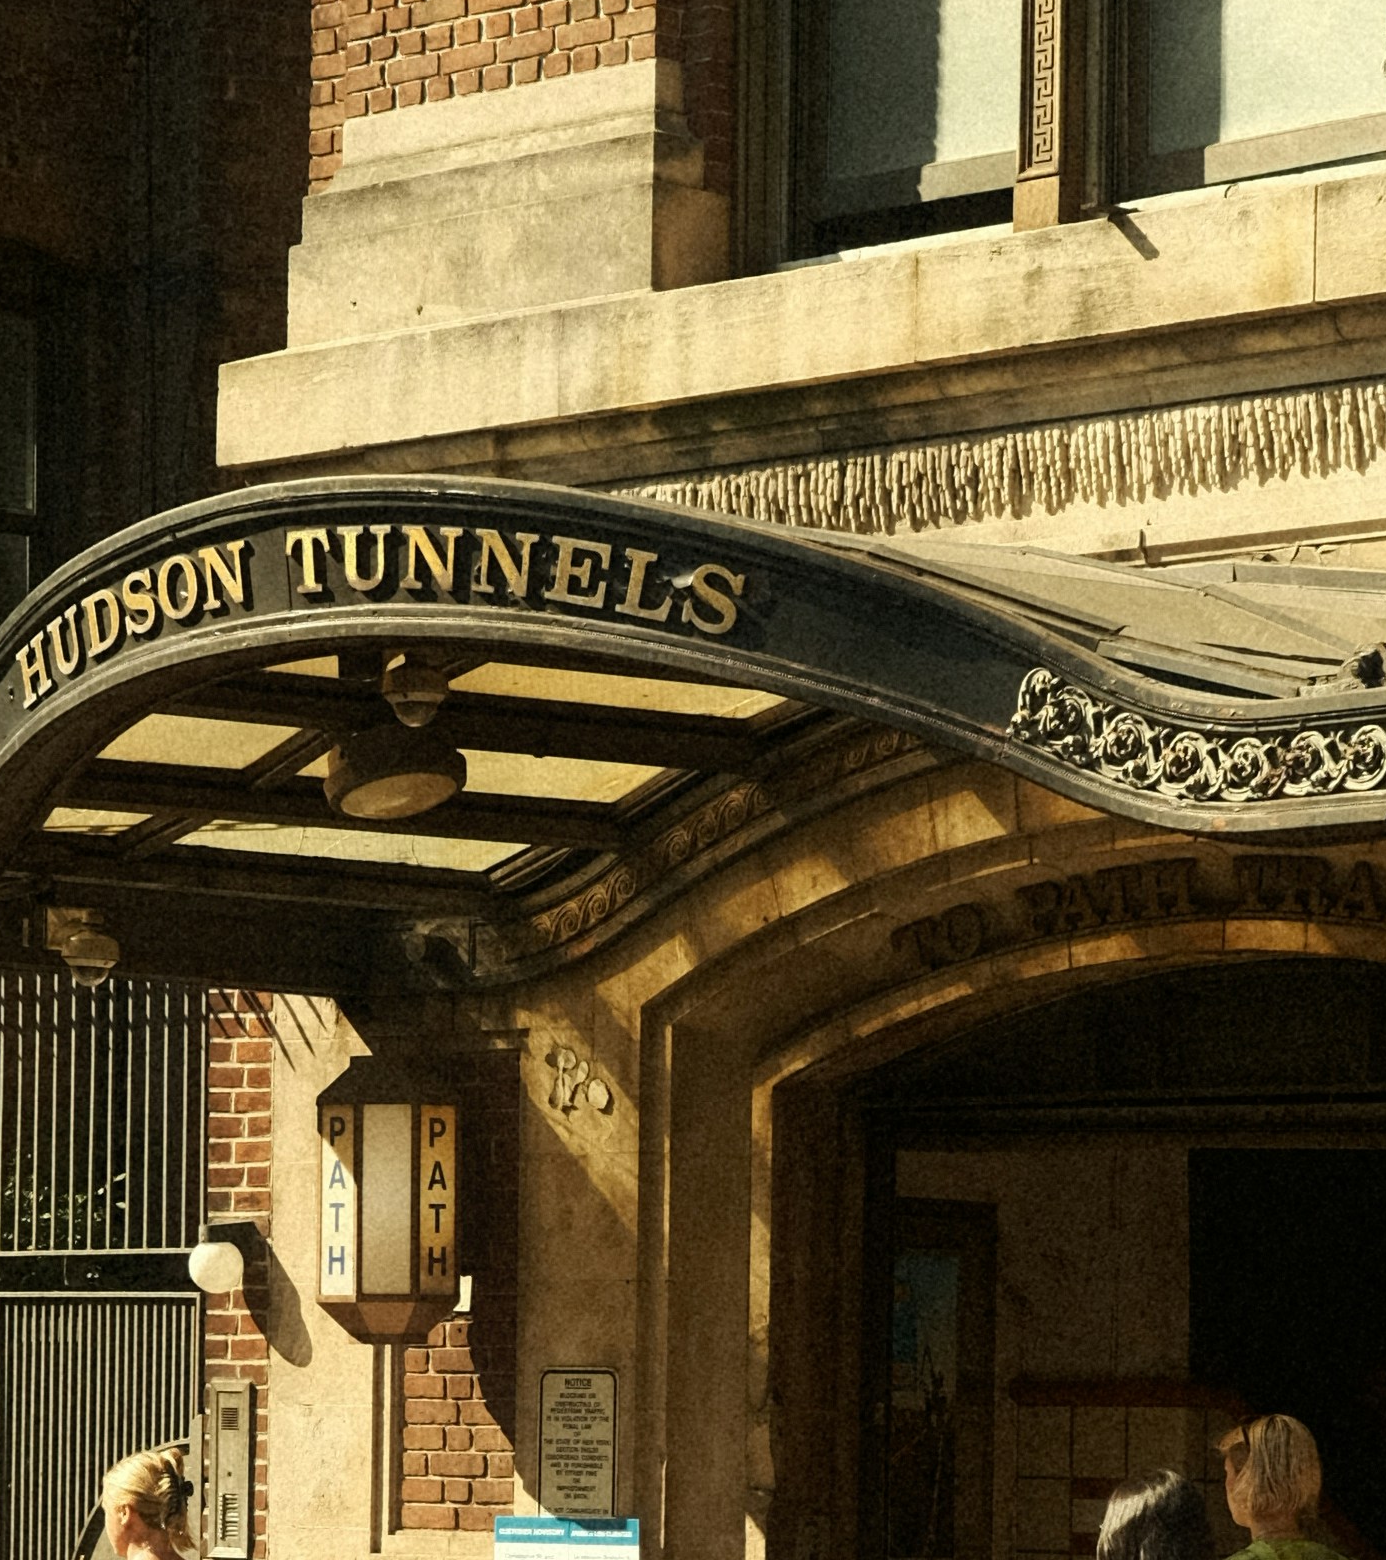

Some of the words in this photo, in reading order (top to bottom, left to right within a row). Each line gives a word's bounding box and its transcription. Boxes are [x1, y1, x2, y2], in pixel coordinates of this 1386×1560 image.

[13, 539, 250, 711] HUDSON
[285, 524, 746, 635] TUNNELS
[891, 901, 987, 970] TO
[1017, 856, 1199, 935] PATH
[328, 1116, 346, 1275] PATH
[428, 1117, 447, 1277] PATH
[564, 1378, 592, 1388] NOTICE
